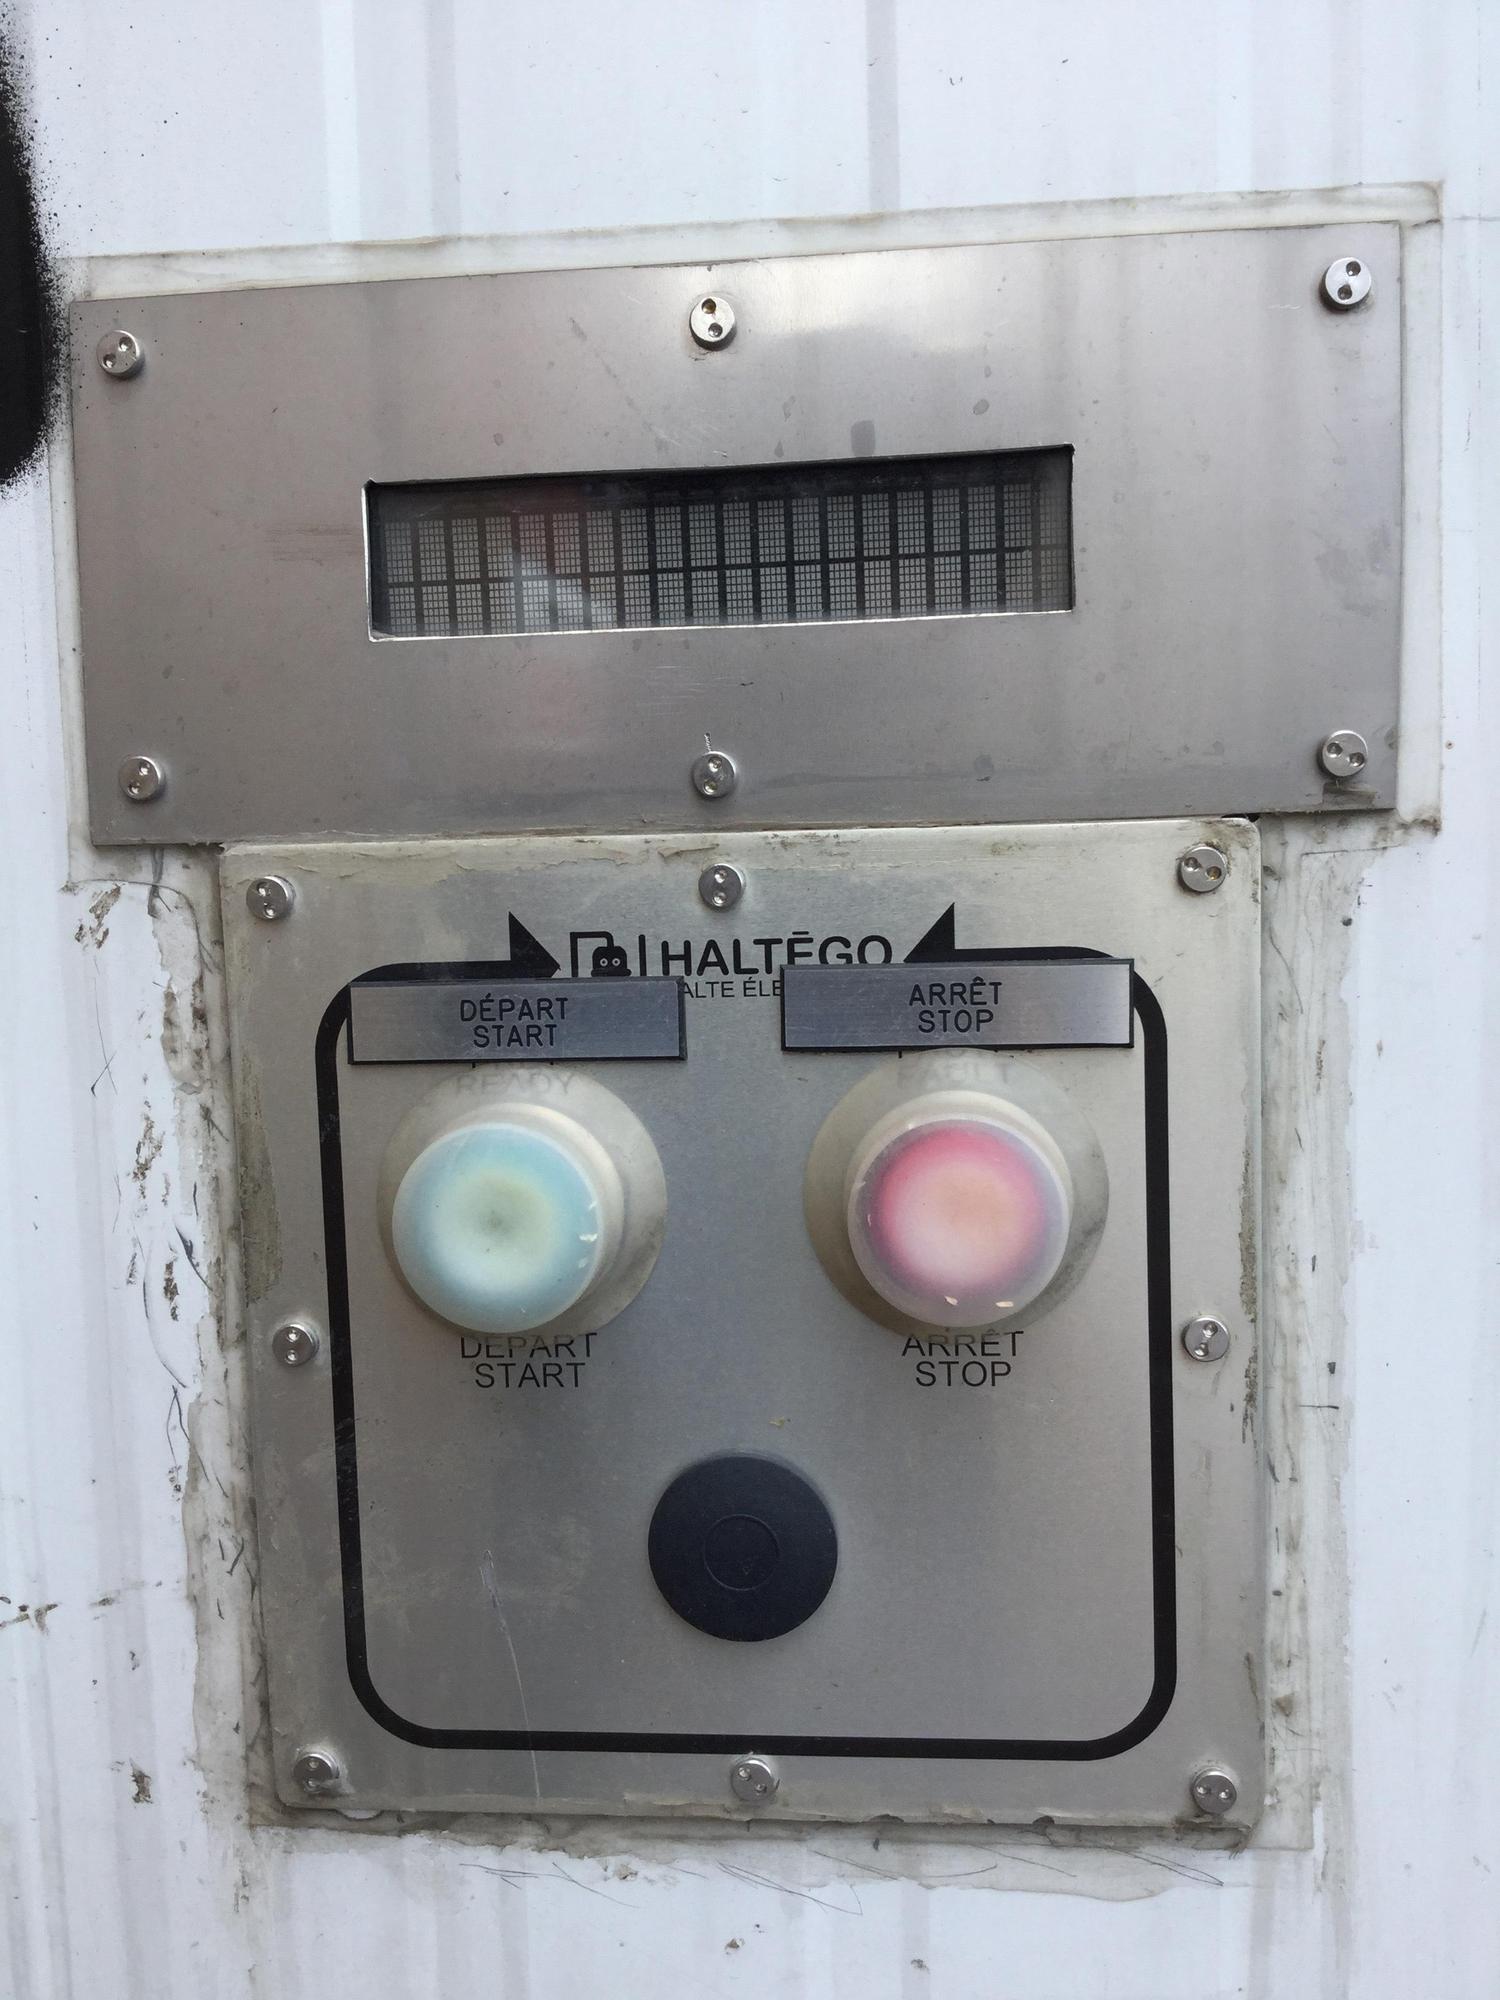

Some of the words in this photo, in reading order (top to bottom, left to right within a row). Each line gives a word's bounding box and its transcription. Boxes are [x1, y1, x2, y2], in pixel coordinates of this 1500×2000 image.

[909, 976, 1002, 1007] ARRÊT
[460, 993, 569, 1022] DÉPART
[918, 1008, 994, 1034] STOP
[473, 1024, 557, 1048] START
[902, 1329, 1024, 1357] ARRÊT
[475, 1363, 586, 1388] START
[915, 1360, 1012, 1387] STOP
